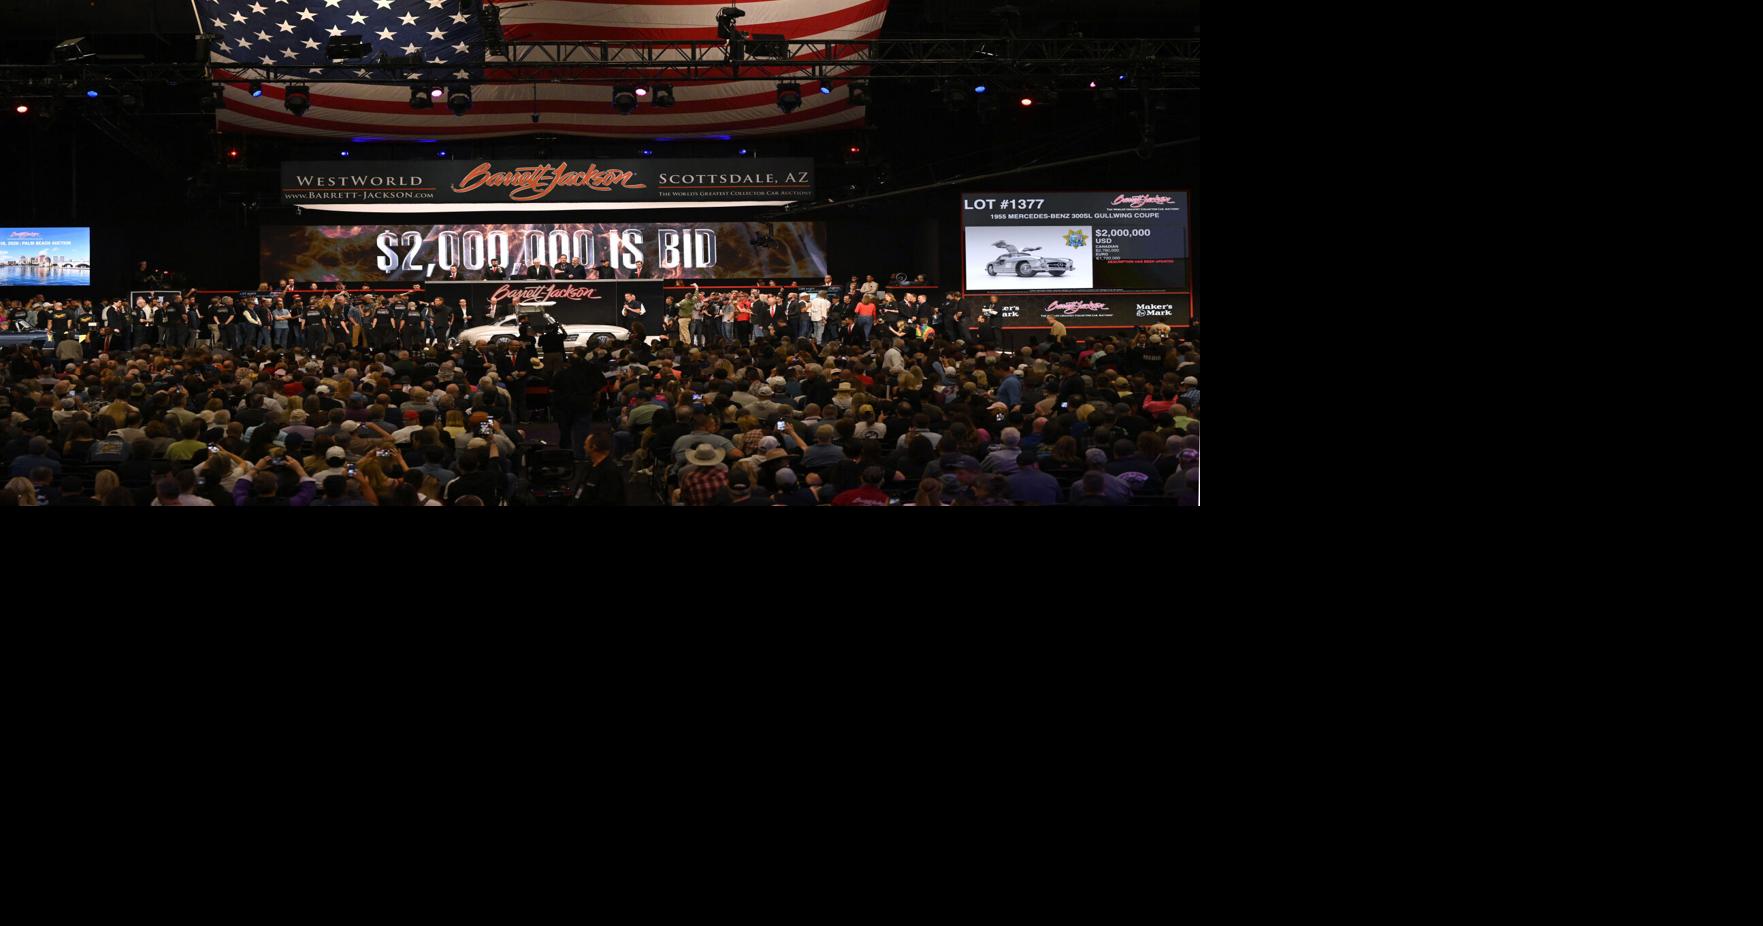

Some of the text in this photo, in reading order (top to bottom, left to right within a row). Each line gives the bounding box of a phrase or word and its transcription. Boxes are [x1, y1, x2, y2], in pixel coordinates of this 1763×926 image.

[296, 175, 423, 187] WESTWORLD
[451, 162, 647, 201] Barrett-Jackson
[658, 171, 809, 184] SCOTTSDALE, AZ
[964, 199, 1045, 210] LOT #1377
[1095, 228, 1151, 237] $2,000,000
[376, 228, 718, 277] $2,000,000 IS BID
[487, 284, 601, 304] Barrett-Jackson
